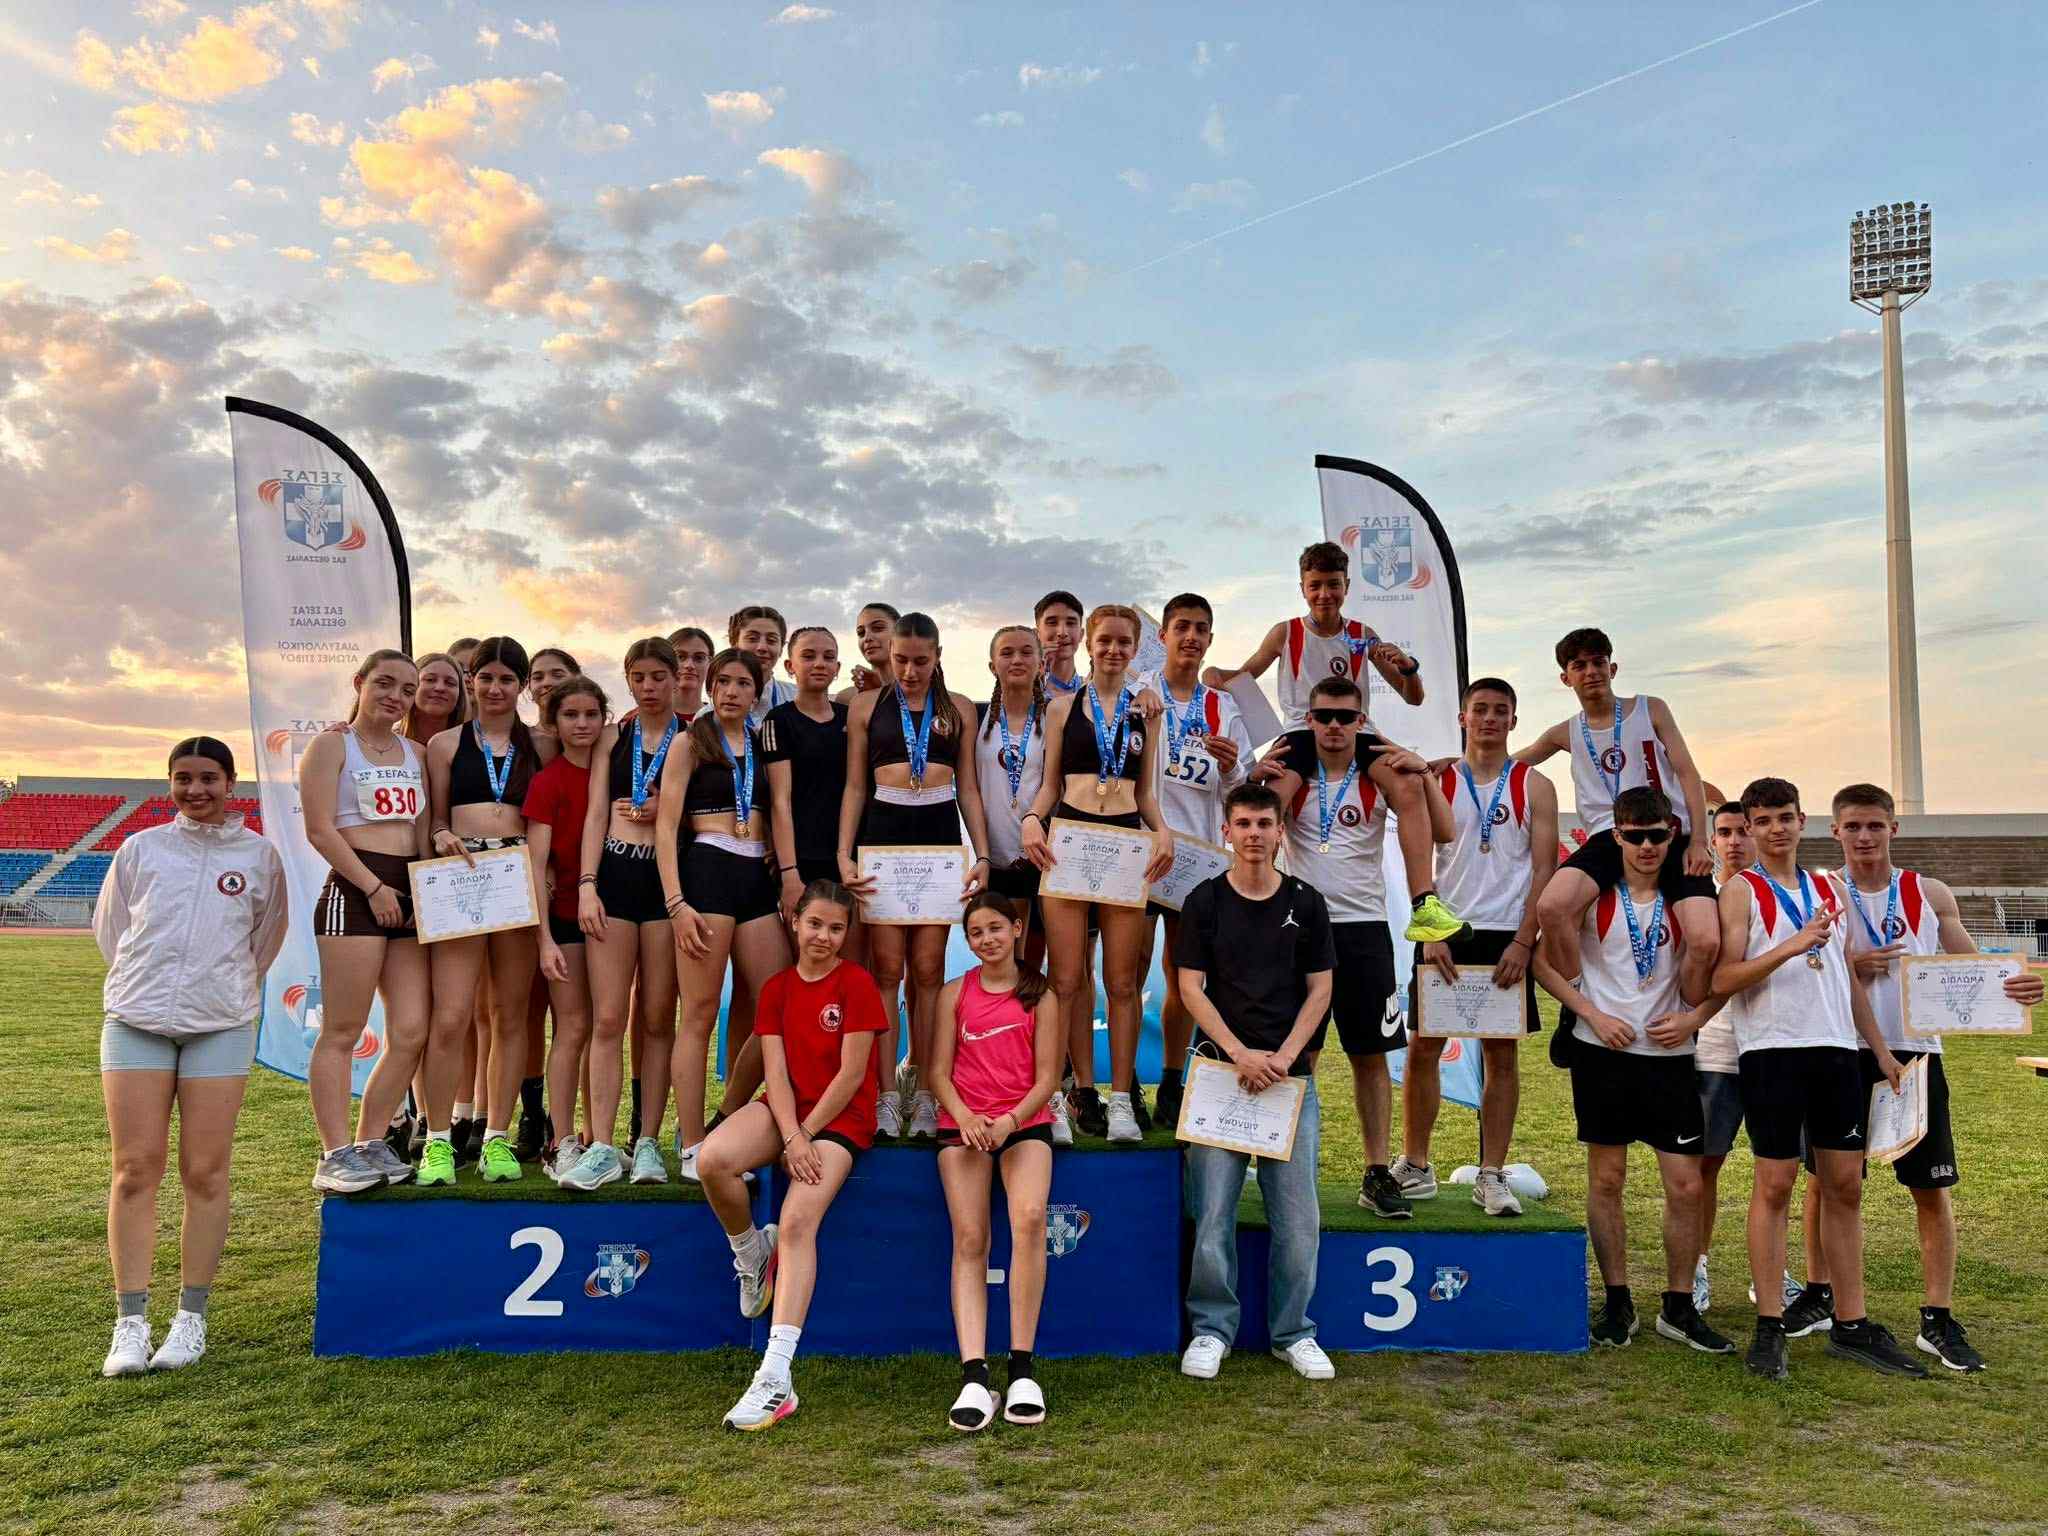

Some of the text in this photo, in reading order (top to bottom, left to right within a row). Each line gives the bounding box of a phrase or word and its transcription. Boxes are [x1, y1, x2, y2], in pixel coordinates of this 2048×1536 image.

[376, 769, 409, 779] ΣΕΓΑΣ
[374, 786, 417, 816] 830
[1081, 843, 1121, 857] ΔΙΠΛΩΜΑ
[893, 866, 934, 875] ΔΙΠΛΩΜΑ
[1940, 974, 1985, 985] ΔΙΠΛΩΜΑ
[1451, 983, 1491, 993] ΔΙΠΛΩΜΑ
[503, 1226, 565, 1317] 2
[1363, 1246, 1418, 1332] 3
